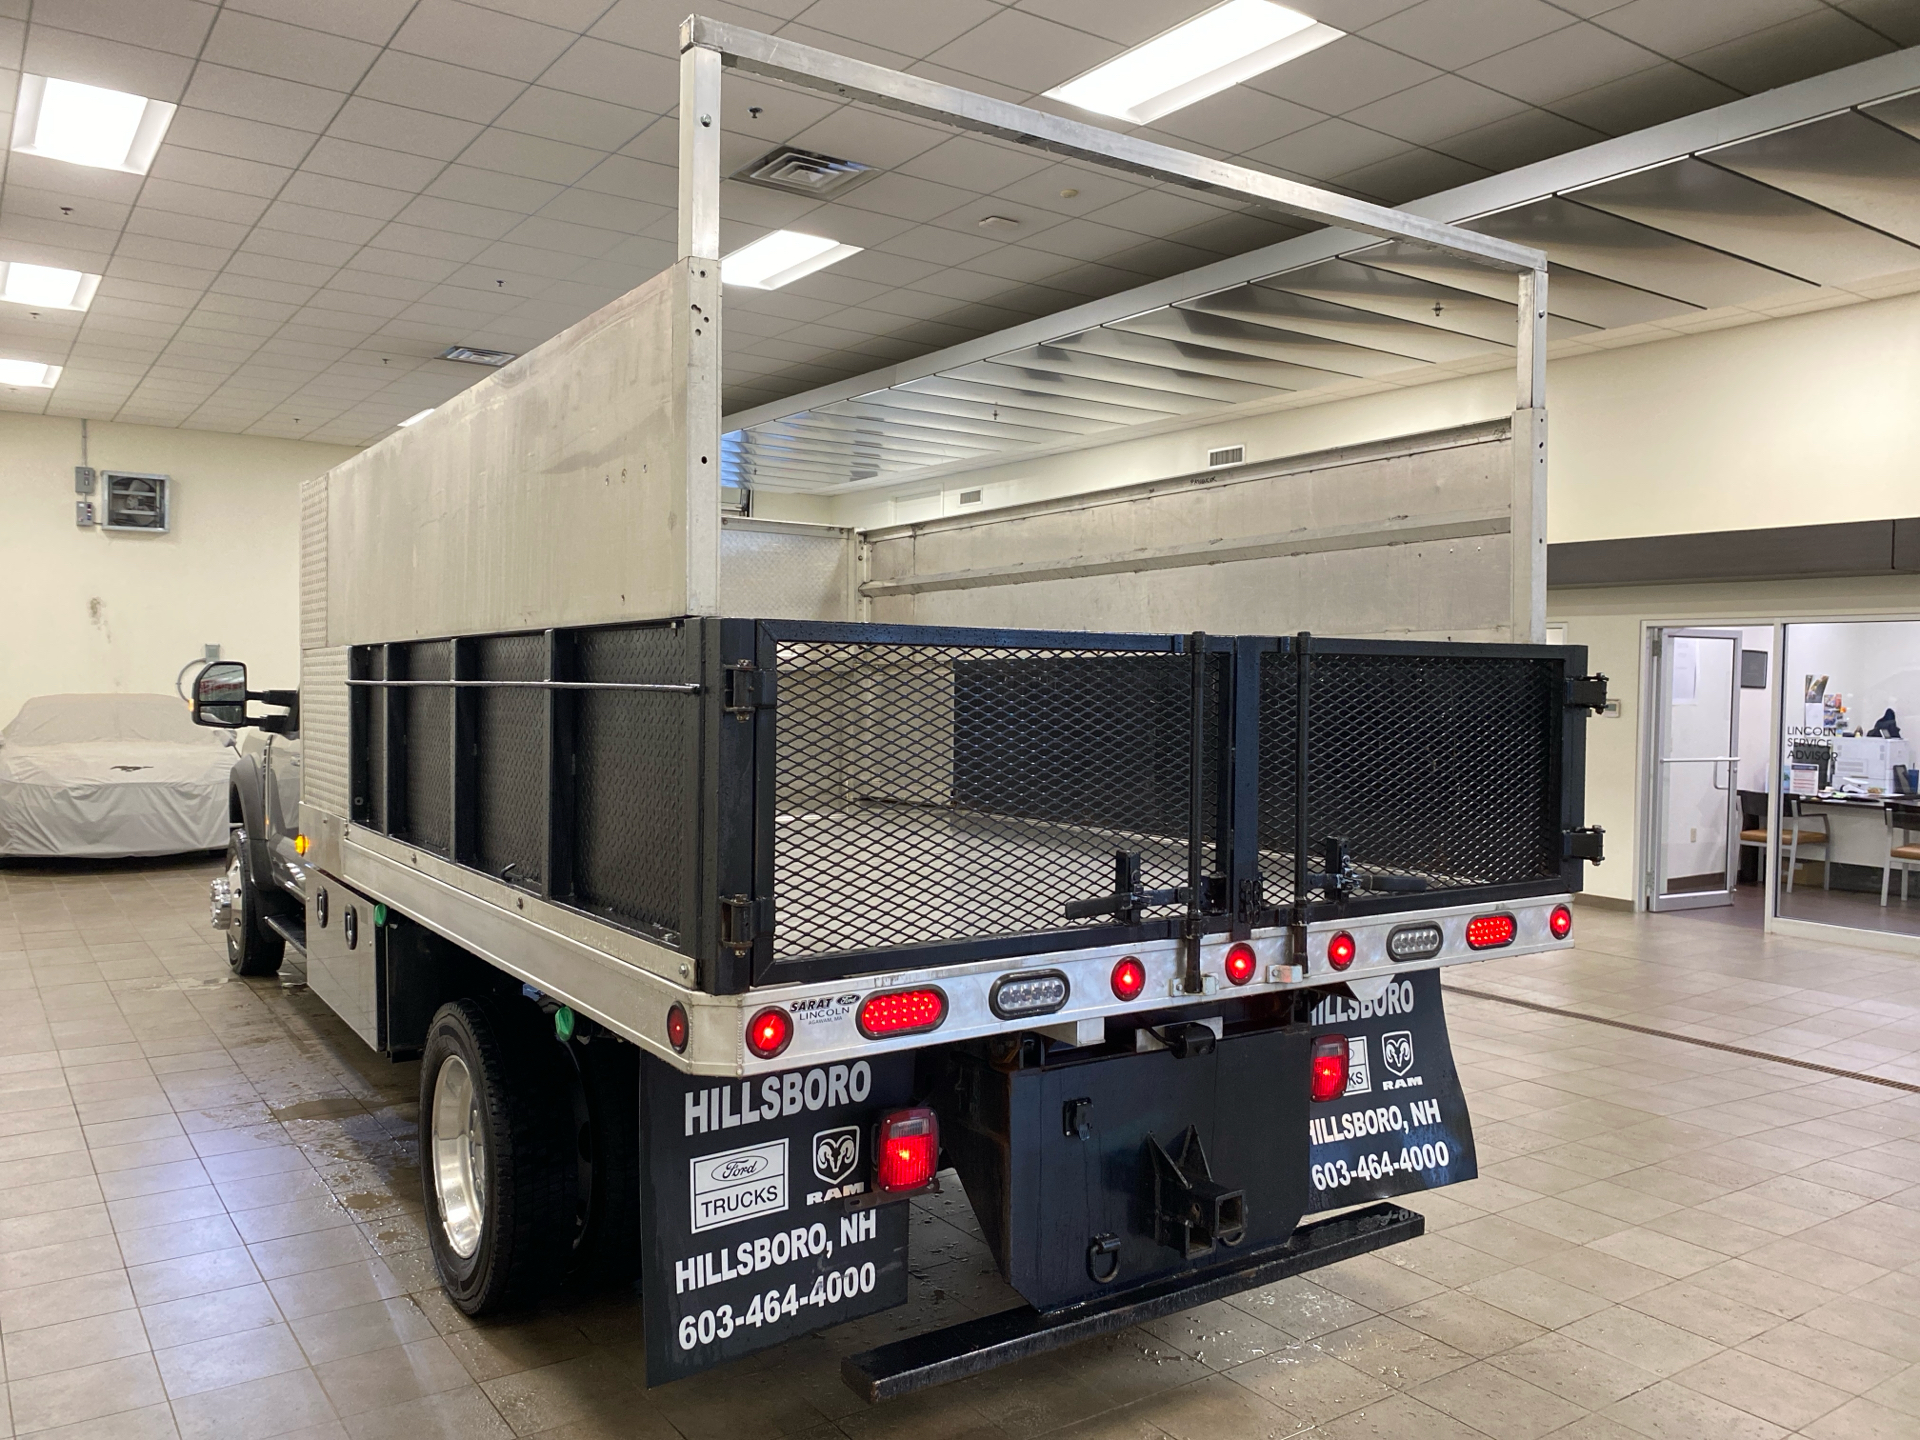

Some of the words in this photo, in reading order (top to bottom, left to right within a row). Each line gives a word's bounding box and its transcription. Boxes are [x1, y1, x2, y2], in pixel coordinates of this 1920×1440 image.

[1787, 726, 1837, 737] LINCOLN
[1787, 738, 1832, 748] SERVICE
[1787, 750, 1838, 762] ADVISOR
[790, 998, 833, 1013] SARAT
[799, 1006, 850, 1021] LINCOLN
[1382, 1076, 1423, 1090] RAM
[685, 1060, 872, 1137] HILLSBORO
[1410, 1099, 1442, 1127] NH
[722, 1158, 758, 1180] Ford
[1311, 1141, 1450, 1191] 603-464-4000
[701, 1185, 778, 1218] TRUCKS
[806, 1182, 864, 1206] RAM
[675, 1222, 833, 1295] HILLSBORO,
[840, 1209, 877, 1244] NH
[678, 1261, 876, 1351] 603-464-4000
